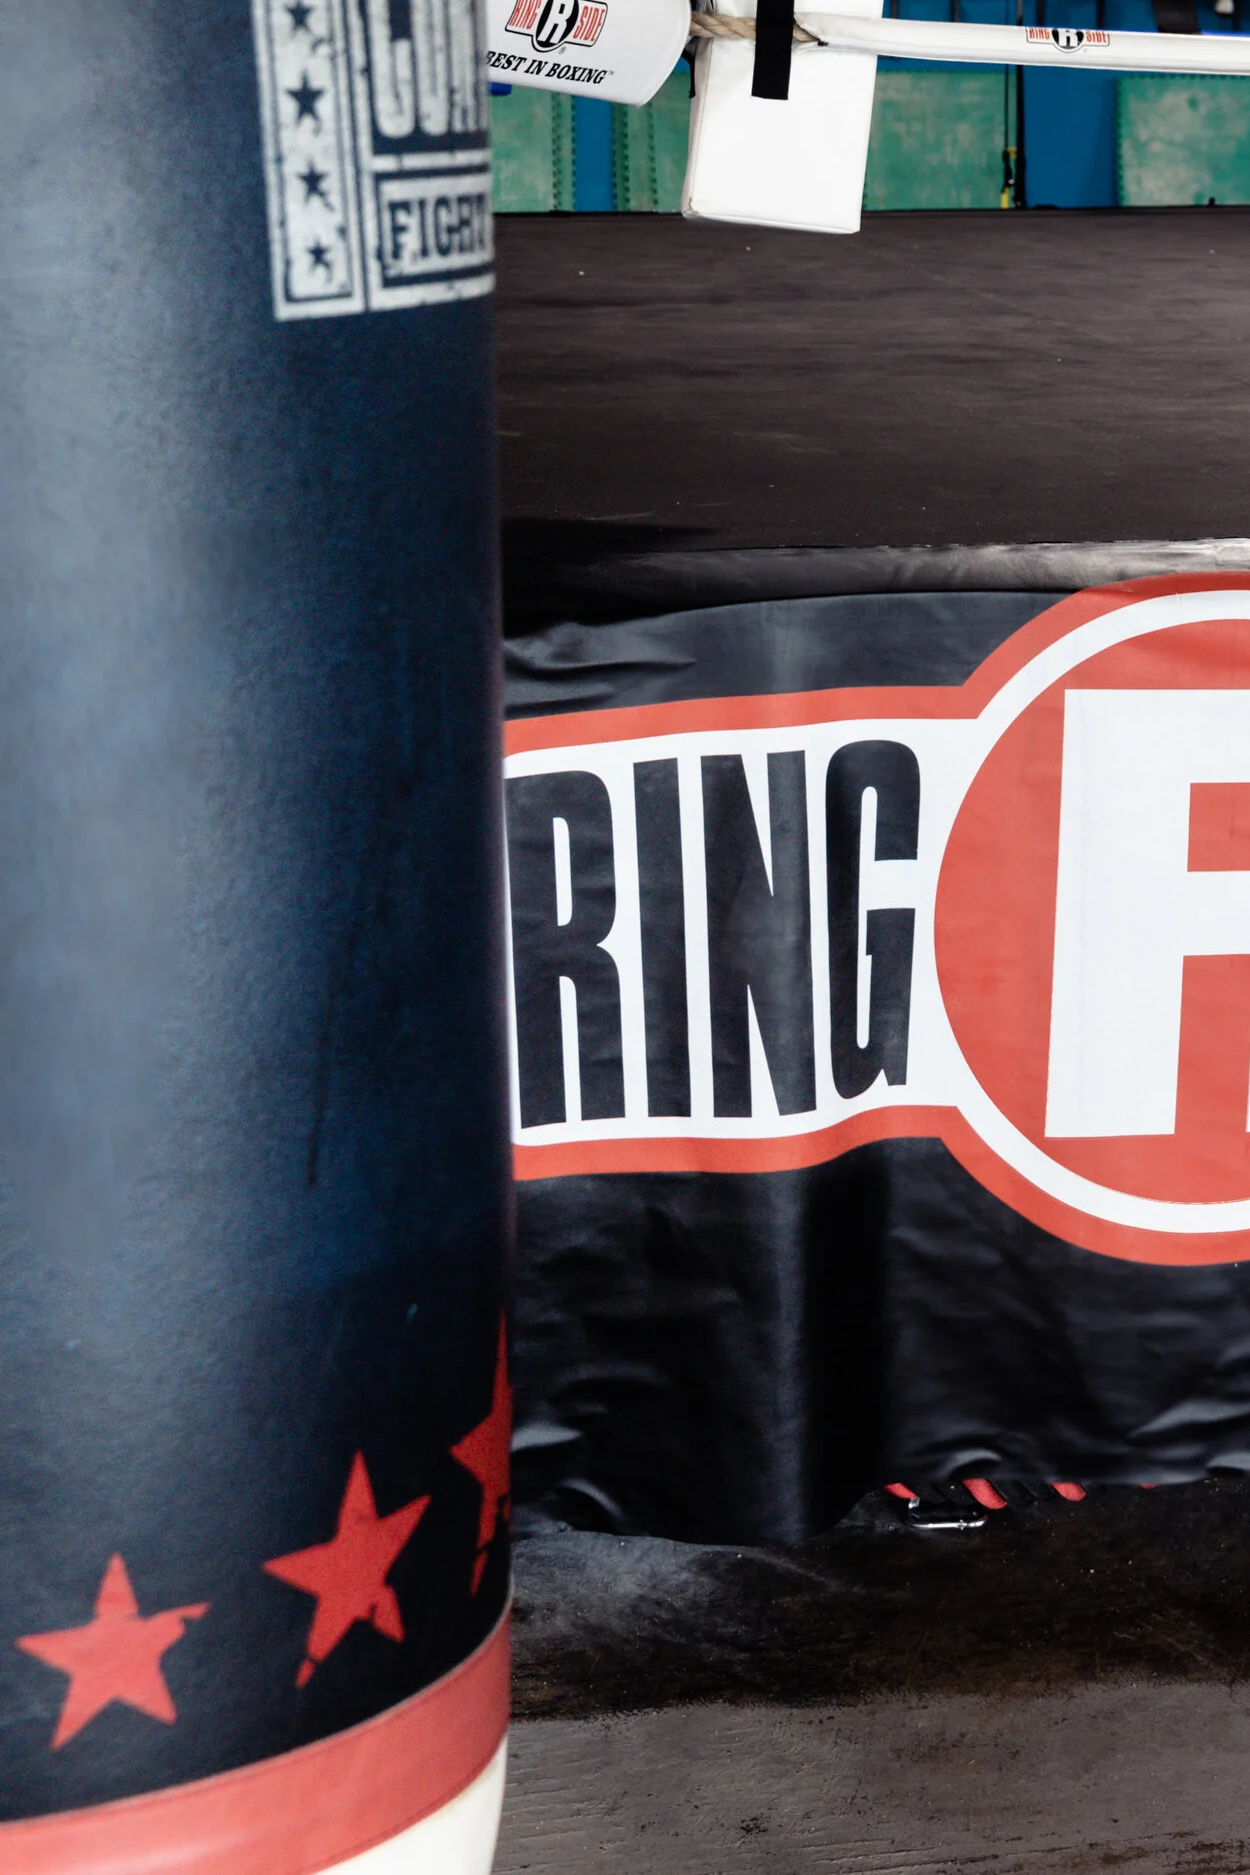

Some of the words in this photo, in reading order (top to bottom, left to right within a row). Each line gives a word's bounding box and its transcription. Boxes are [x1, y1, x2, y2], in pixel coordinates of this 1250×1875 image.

[572, 5, 605, 42] SIDE
[525, 60, 549, 76] IN
[549, 65, 608, 85] BOXING
[503, 739, 921, 1129] RING
